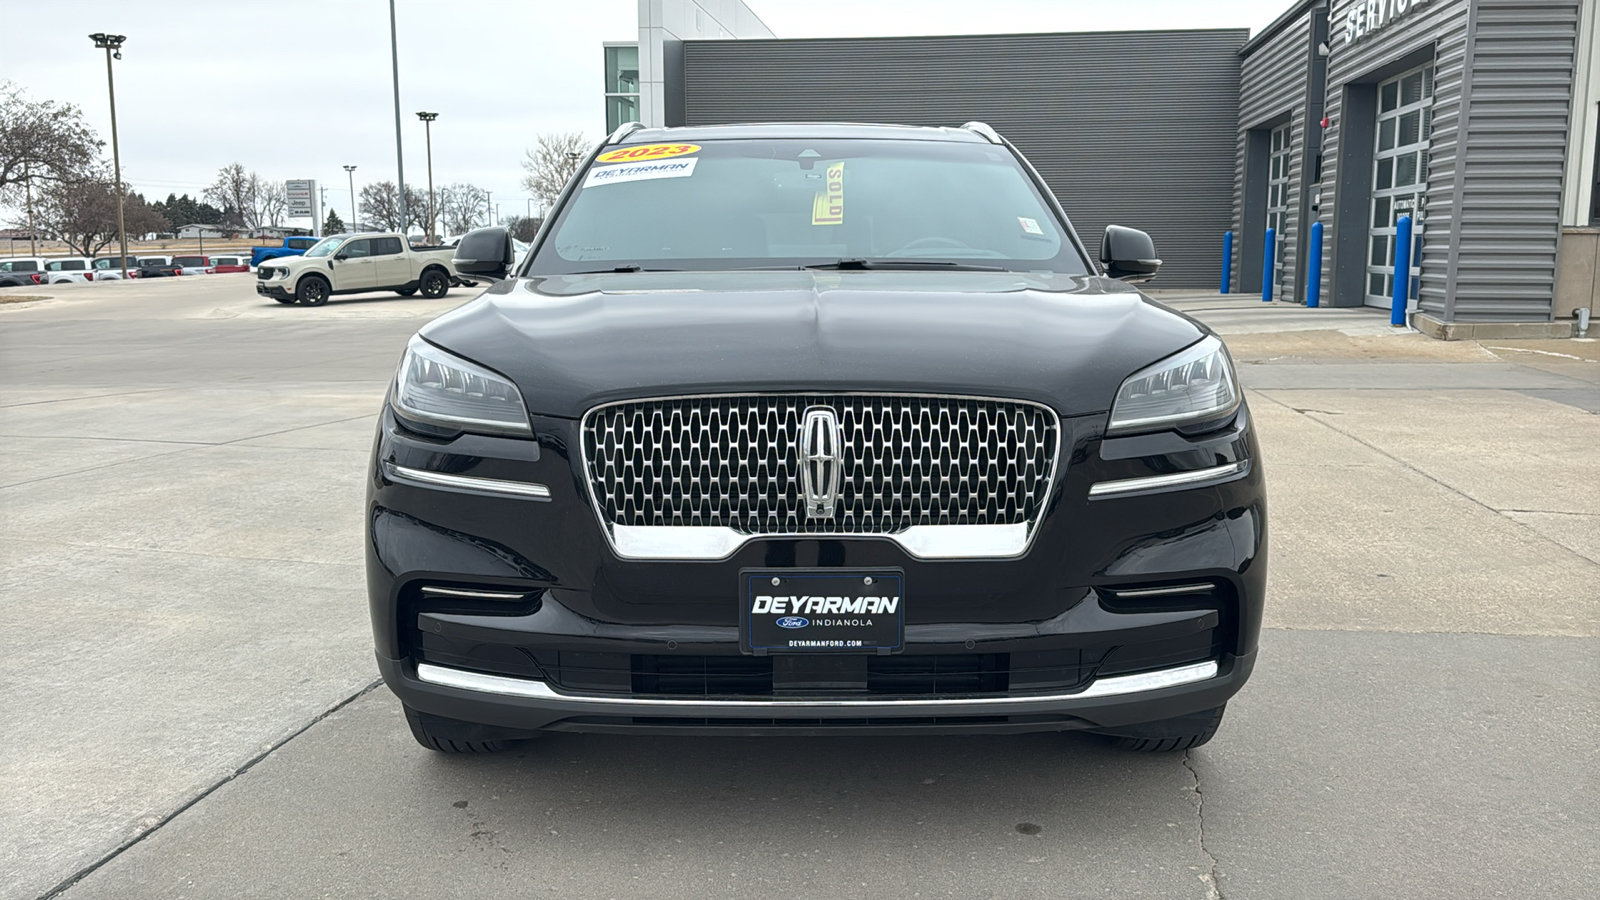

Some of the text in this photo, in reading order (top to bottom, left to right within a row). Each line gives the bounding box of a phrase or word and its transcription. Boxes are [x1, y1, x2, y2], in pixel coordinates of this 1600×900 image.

[606, 145, 692, 161] 2023
[594, 163, 690, 178] DEYARMAN
[828, 169, 843, 216] SOLD
[752, 596, 899, 614] DEYARMAN
[812, 619, 873, 627] INDIANOLA
